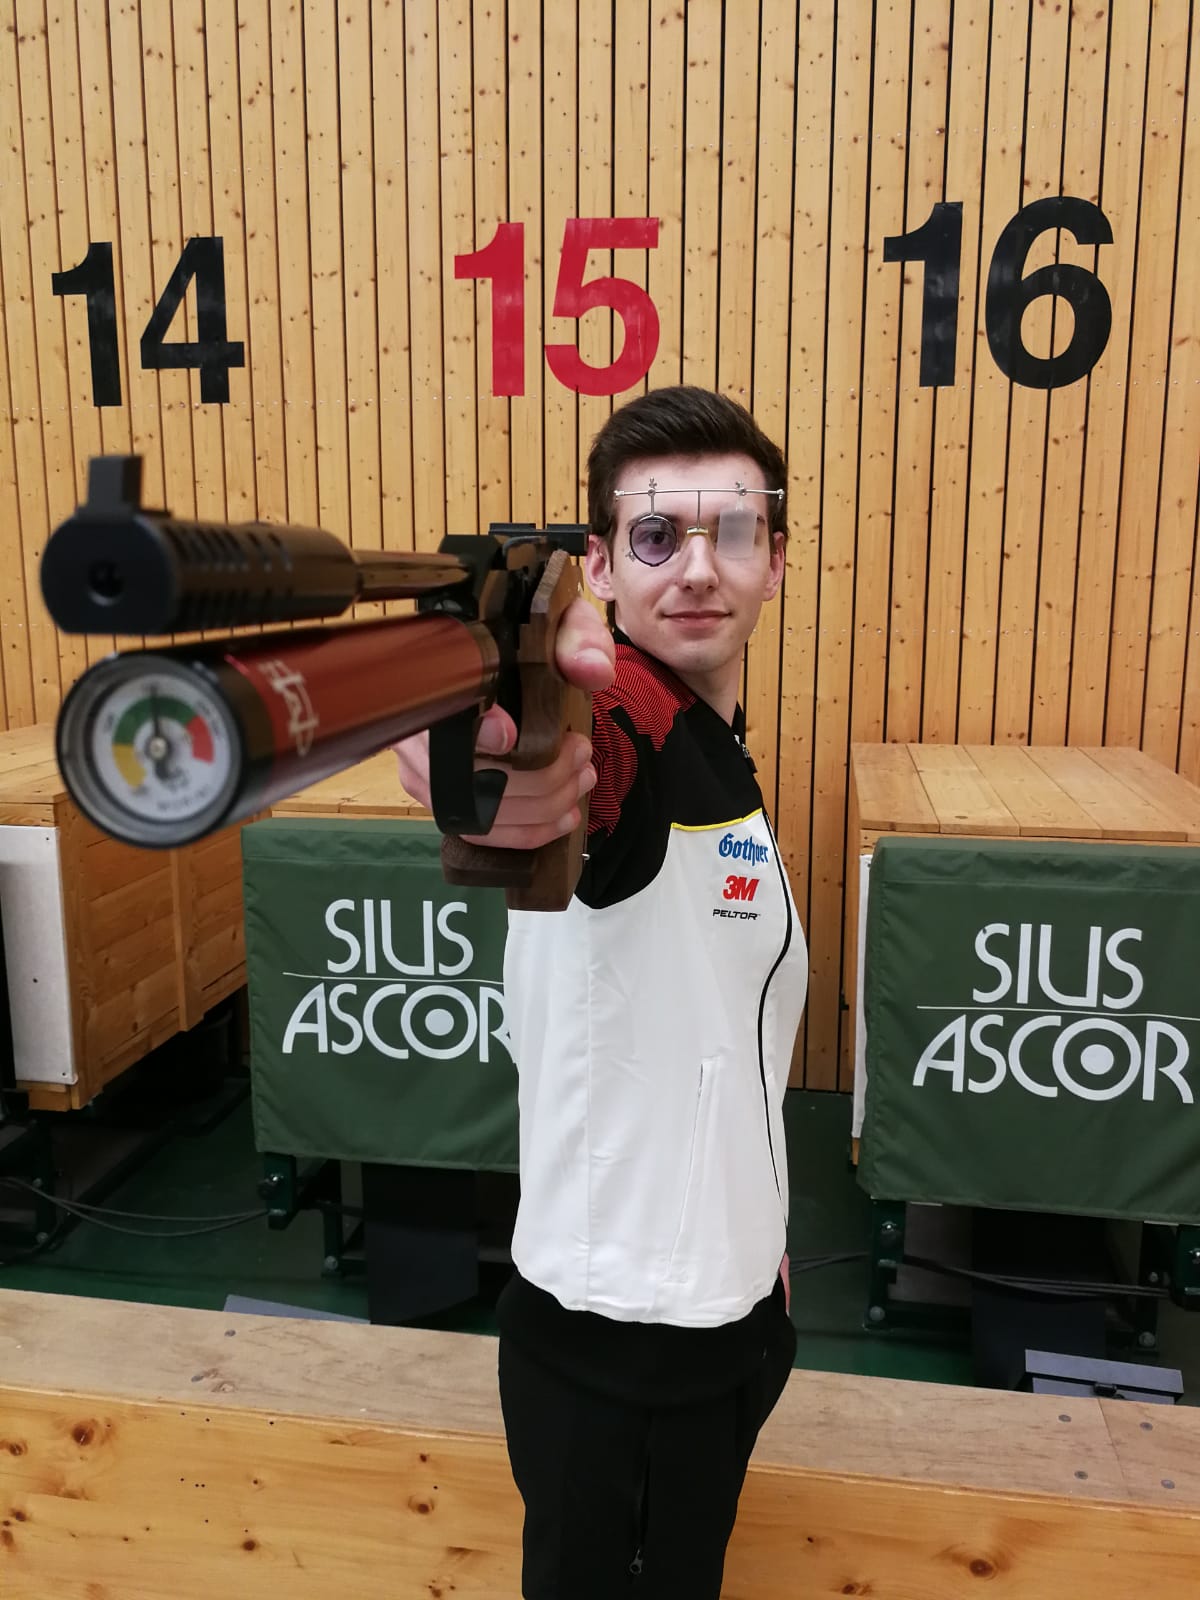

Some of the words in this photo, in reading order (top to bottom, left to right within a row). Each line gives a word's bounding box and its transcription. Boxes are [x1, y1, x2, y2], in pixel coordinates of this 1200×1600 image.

[52, 236, 245, 407] 14
[454, 217, 660, 397] 15
[883, 196, 1114, 389] 16
[712, 908, 758, 921] PELTOR
[723, 875, 760, 901] 3M
[325, 899, 474, 976] SIUS
[973, 923, 1144, 1009] SIUS
[282, 982, 517, 1063] ASCOR
[913, 1014, 1194, 1104] ASCOR
